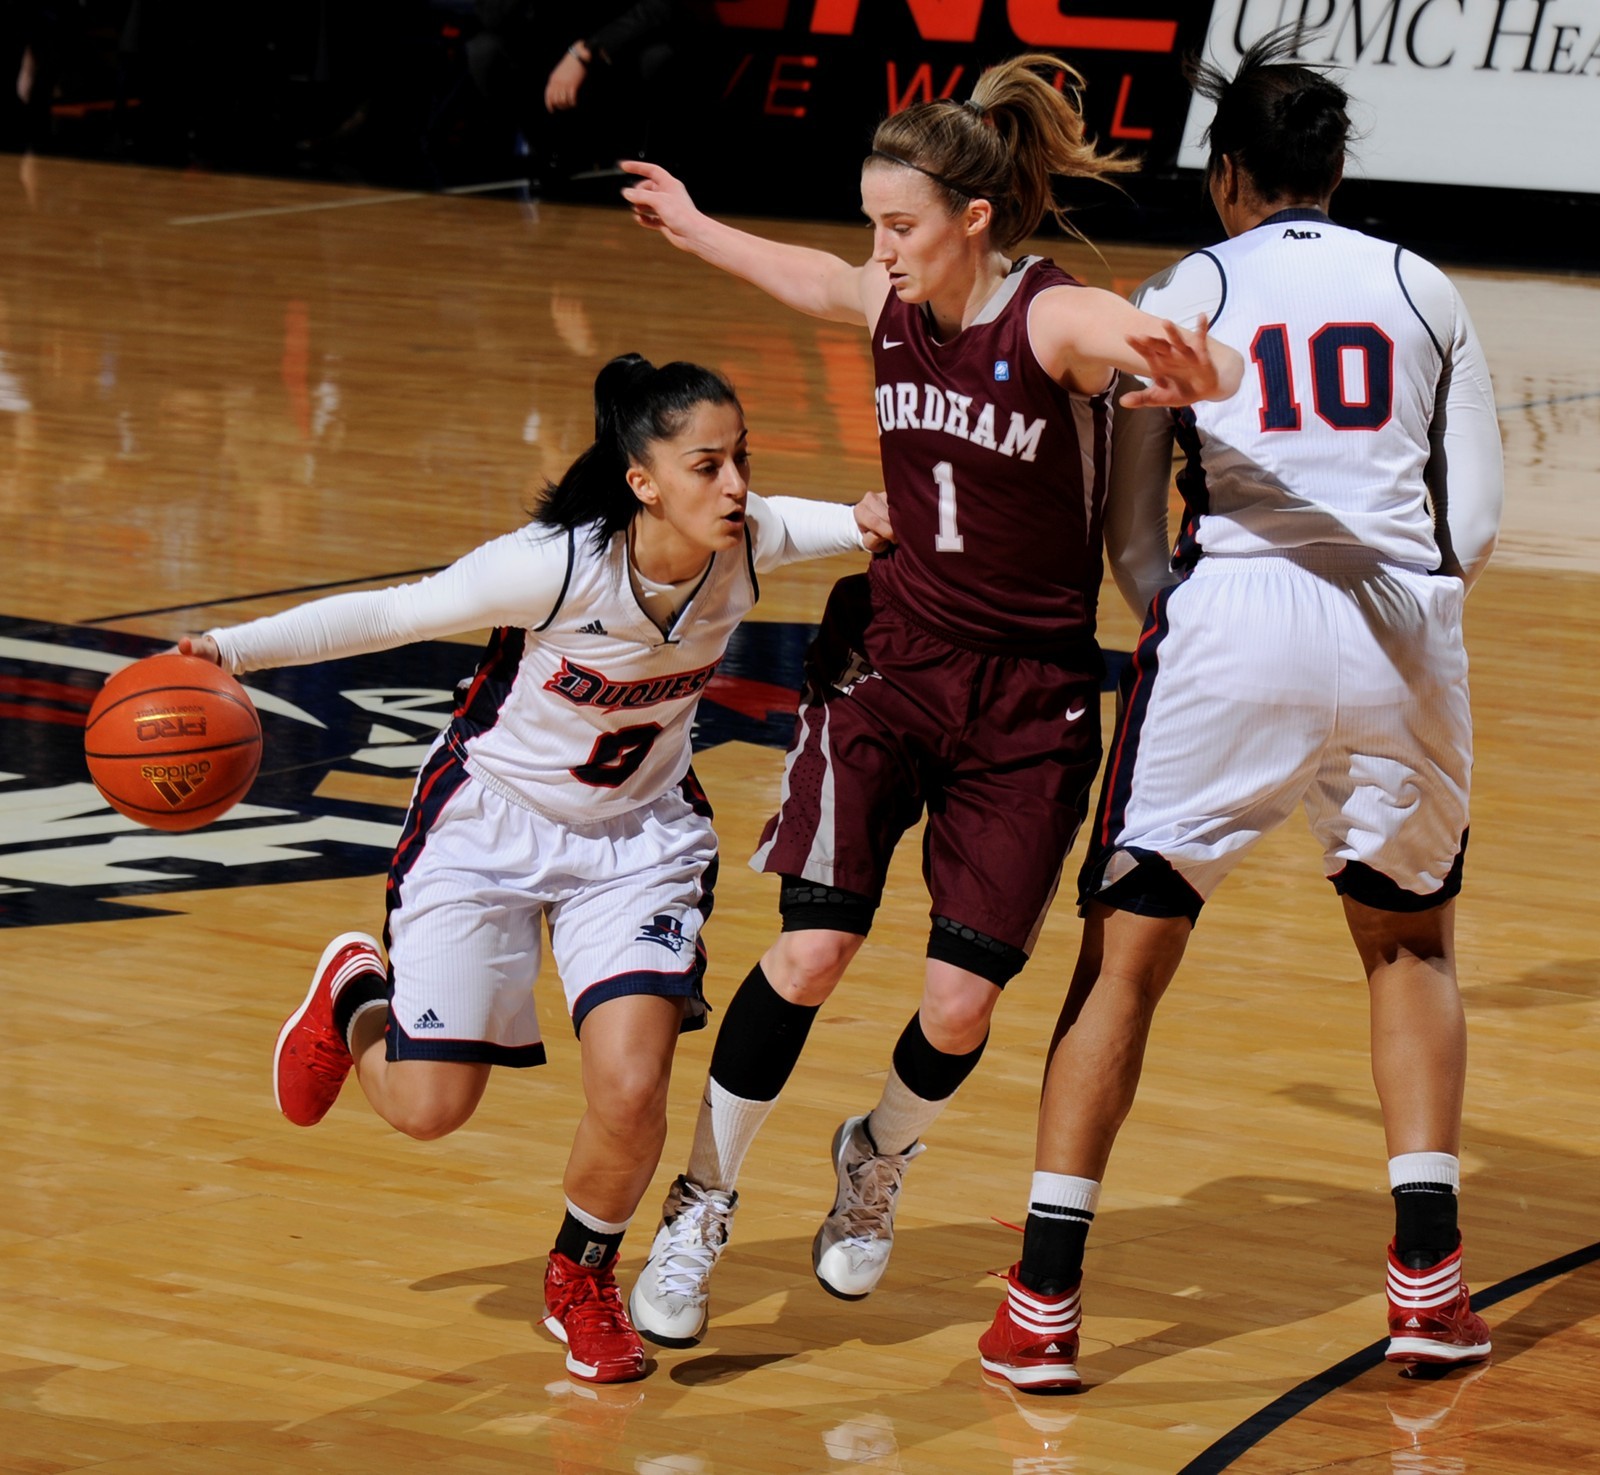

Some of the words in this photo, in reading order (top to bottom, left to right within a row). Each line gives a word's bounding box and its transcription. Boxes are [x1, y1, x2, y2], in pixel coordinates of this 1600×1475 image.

[1234, 0, 1463, 69] UPMC
[1249, 322, 1394, 433] 10
[932, 461, 964, 552] 1
[141, 760, 212, 781] adidas
[569, 721, 664, 789] 0
[413, 1021, 445, 1029] adidas
